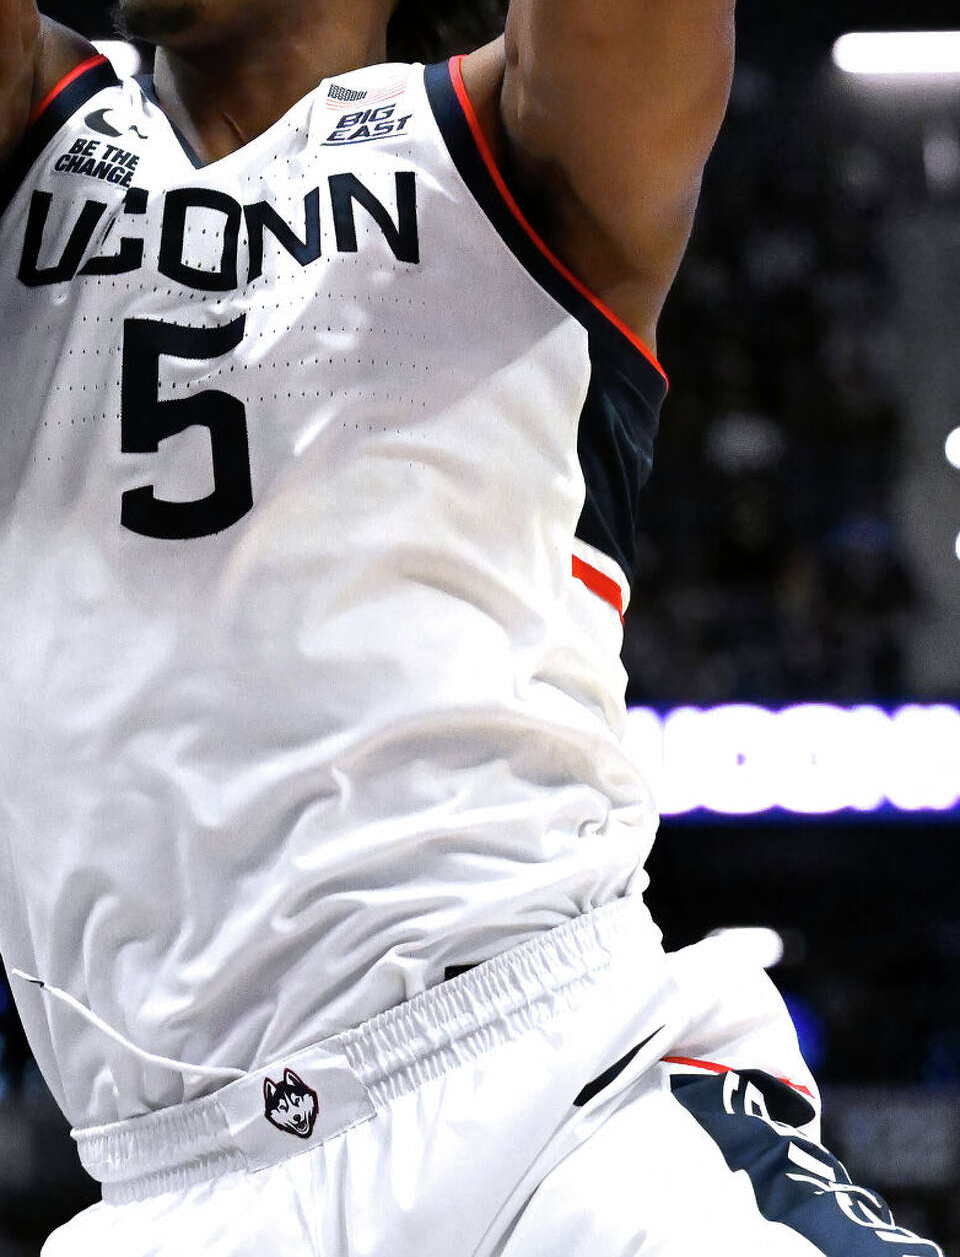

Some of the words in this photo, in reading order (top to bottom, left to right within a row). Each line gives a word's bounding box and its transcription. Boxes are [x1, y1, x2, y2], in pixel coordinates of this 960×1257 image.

[326, 114, 413, 141] EAST
[336, 103, 396, 129] BIG
[54, 154, 134, 188] CHANGE
[69, 138, 101, 157] BE
[102, 144, 140, 171] THE
[16, 171, 421, 292] UCONN
[120, 314, 254, 540] 5
